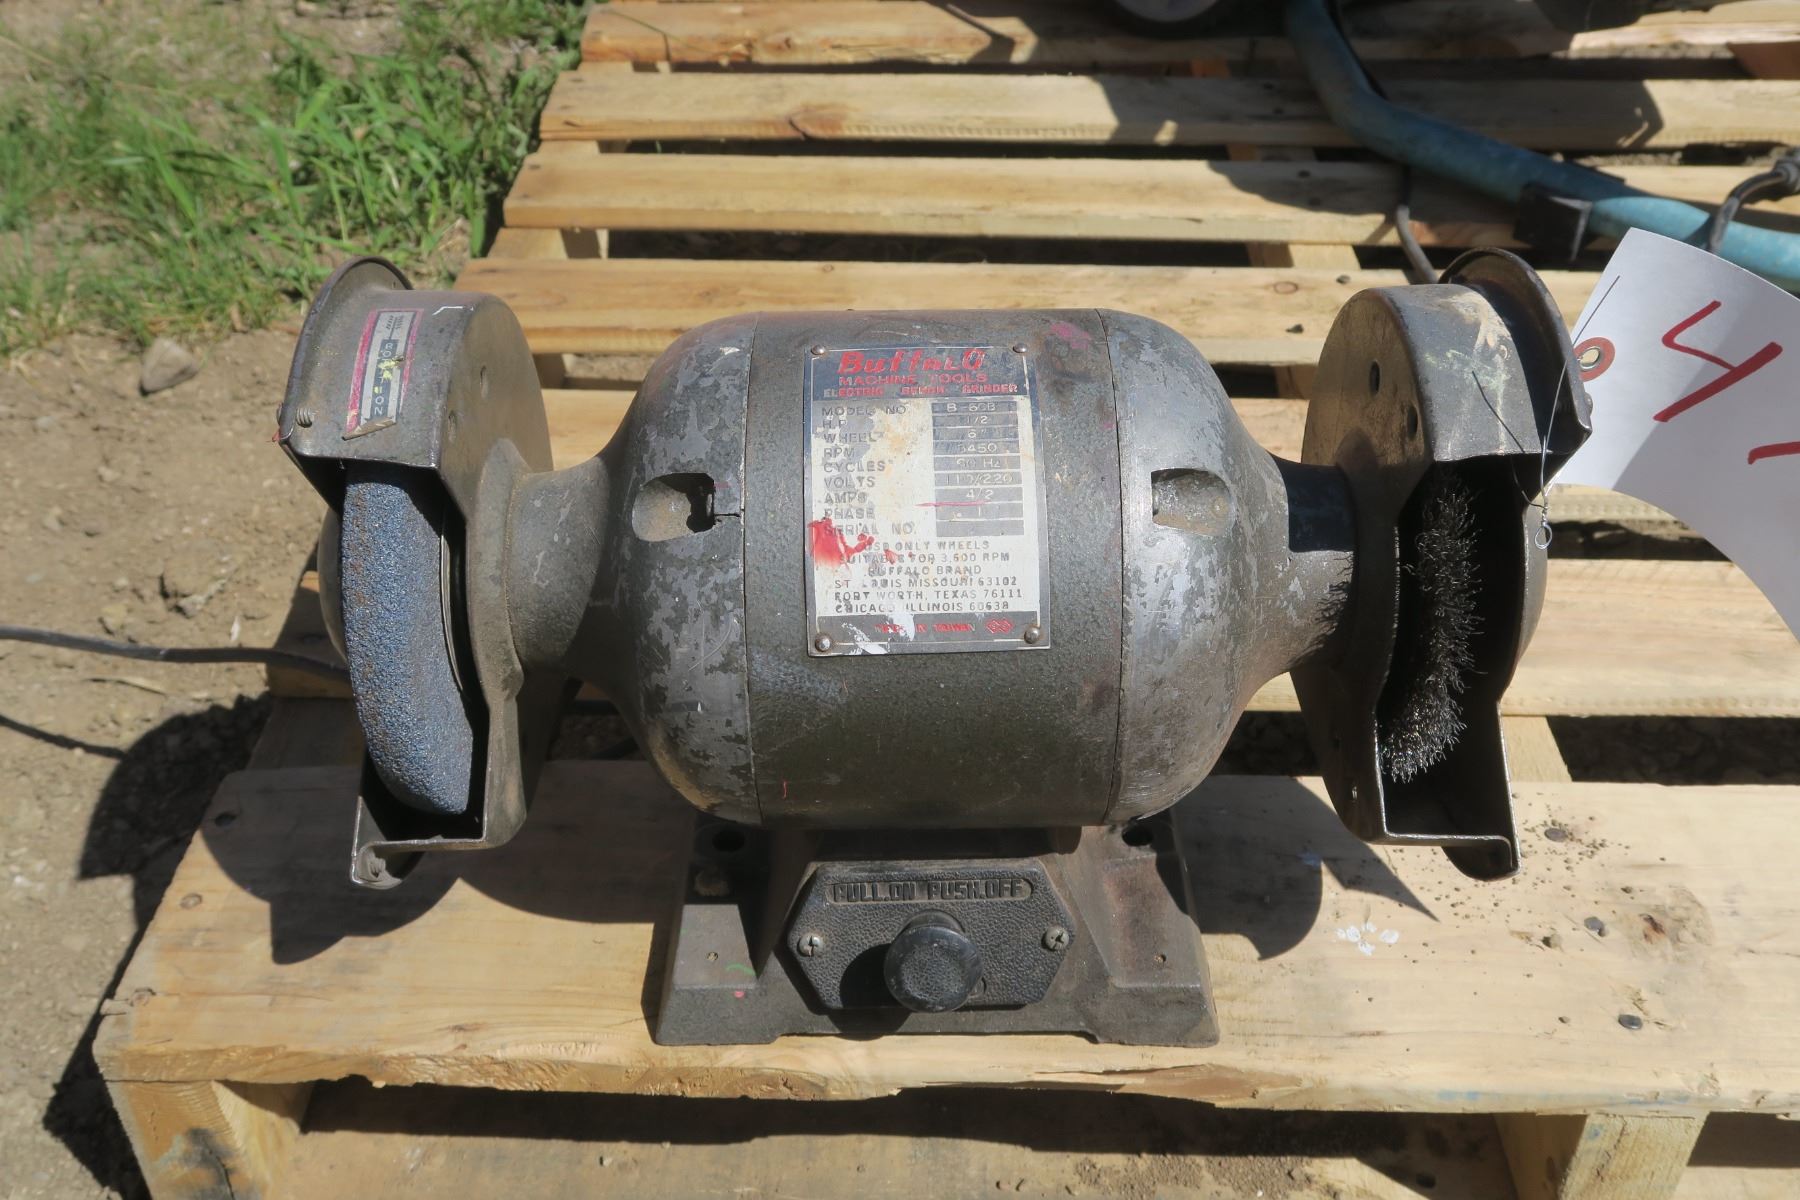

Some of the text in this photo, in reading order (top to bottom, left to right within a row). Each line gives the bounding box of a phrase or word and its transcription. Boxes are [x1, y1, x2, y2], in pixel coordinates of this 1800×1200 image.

[838, 373, 989, 387] MACHINE TOOLS
[823, 383, 1018, 398] ELECTRIC BENCH GRINDER
[823, 447, 855, 459] RPM
[823, 460, 886, 473] CYCLES
[823, 476, 876, 489] VOLTS
[823, 491, 868, 504] AMPS
[965, 488, 994, 500] 4/2
[823, 507, 876, 520] PHASE
[894, 541, 931, 551] ONLY
[937, 539, 990, 550] WHEELS
[982, 551, 1010, 561] RPM
[867, 564, 982, 577] BUFFALO BRAND
[908, 576, 974, 588] MISSOURI
[977, 575, 1017, 586] 63102
[834, 590, 871, 602] FORT
[934, 588, 978, 600] TEXAS
[983, 588, 1022, 599] 76111
[835, 602, 896, 614] CHICAGO
[905, 600, 964, 612] ILLINOIS
